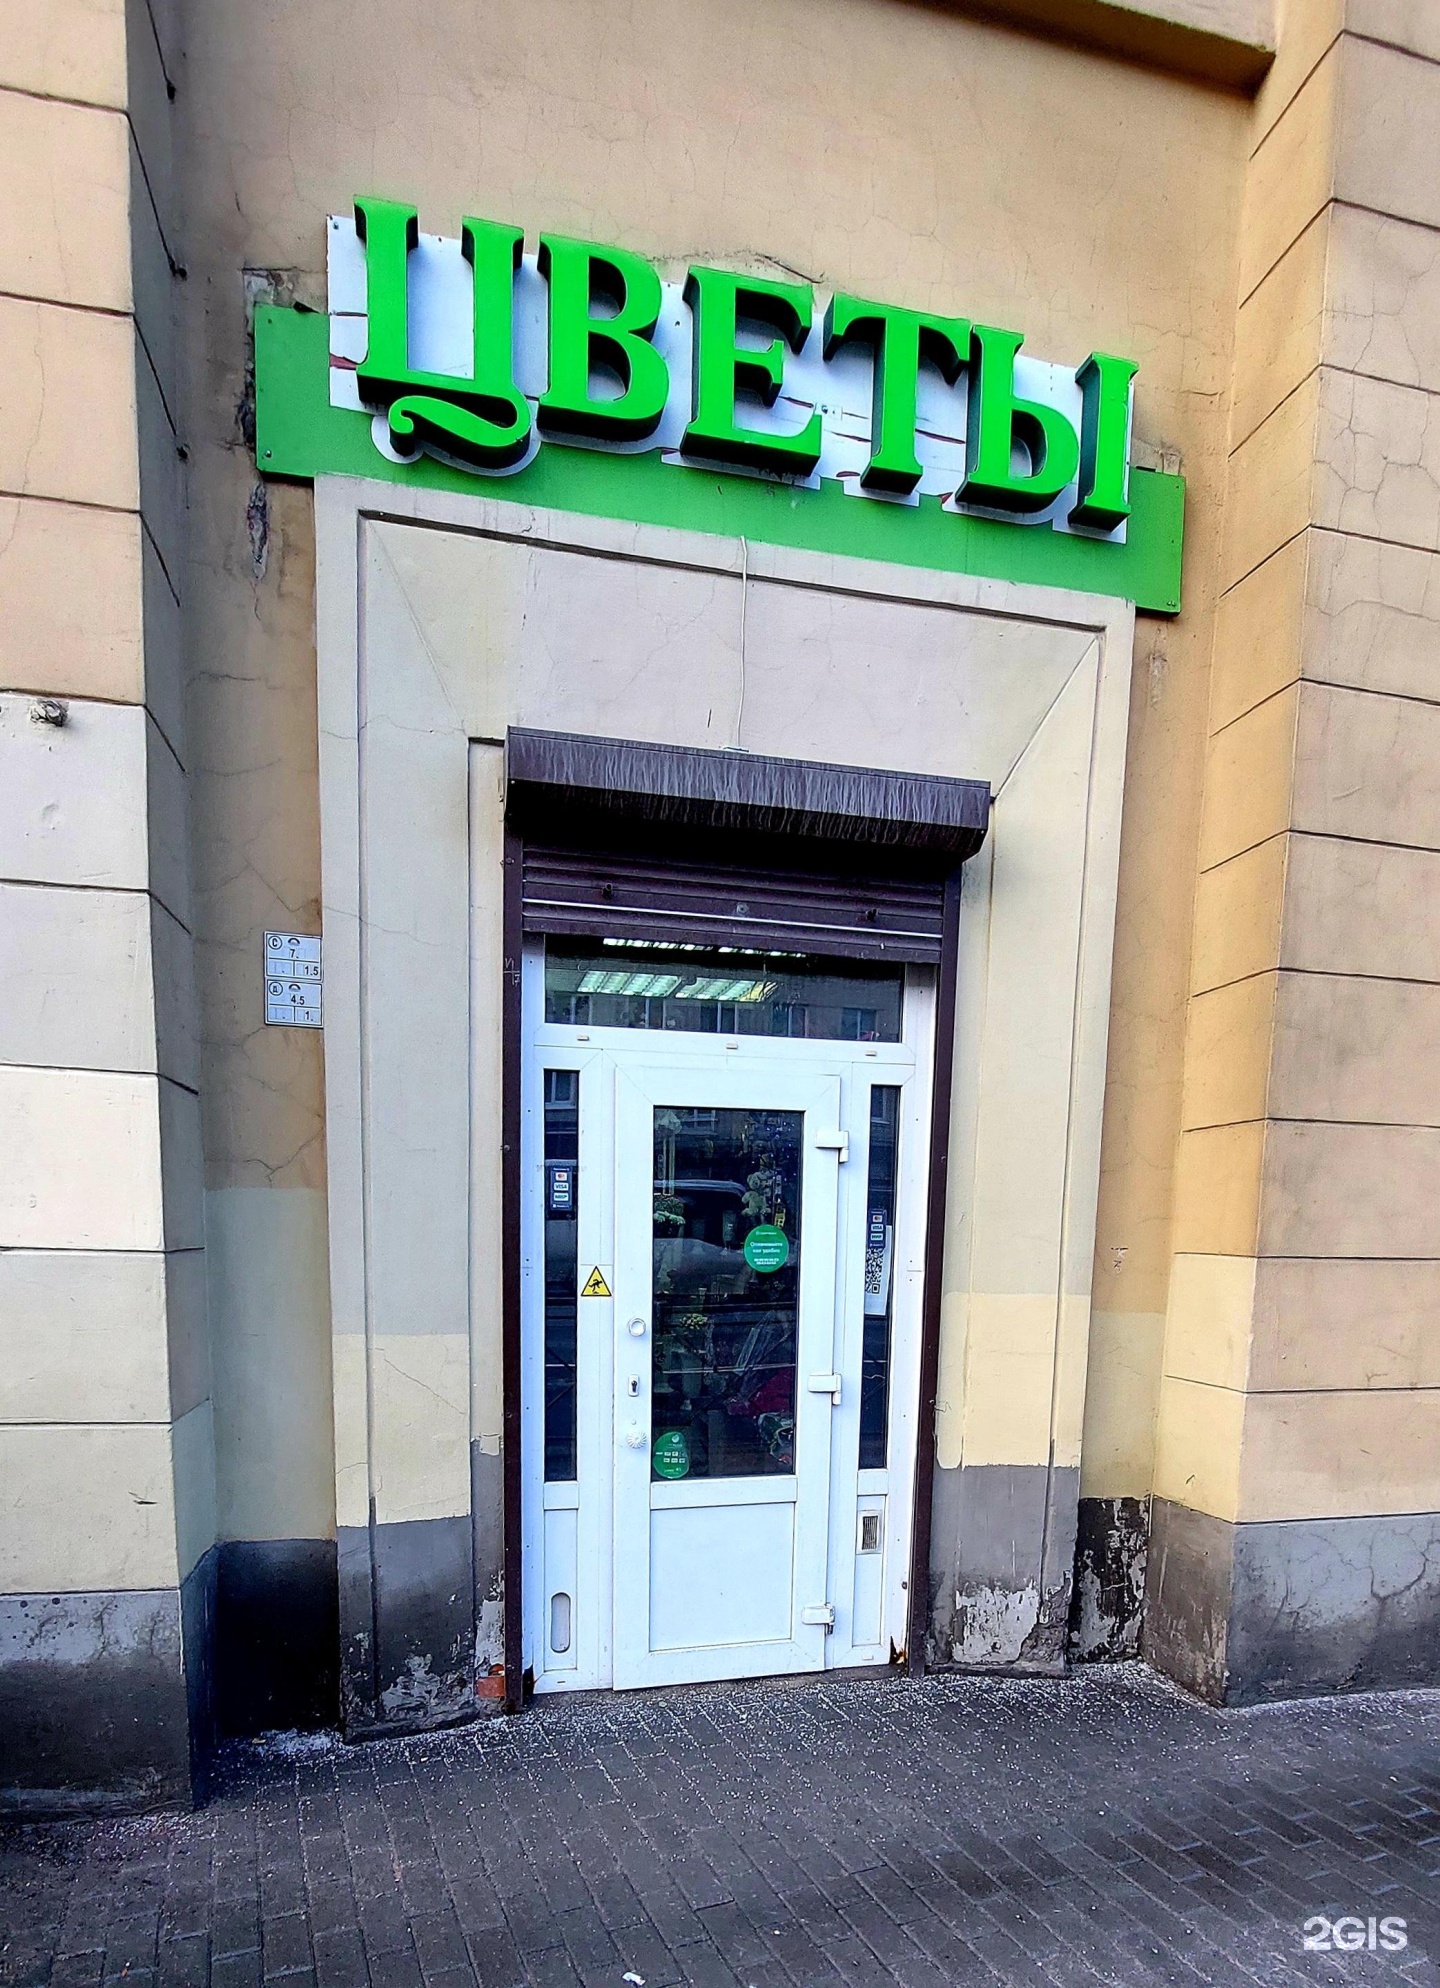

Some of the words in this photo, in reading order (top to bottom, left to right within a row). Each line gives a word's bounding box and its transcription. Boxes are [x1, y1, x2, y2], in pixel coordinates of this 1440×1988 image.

[353, 195, 1139, 529] ЦВЕТЫ
[305, 966, 318, 976] 1.5
[291, 994, 304, 1005] 4.5
